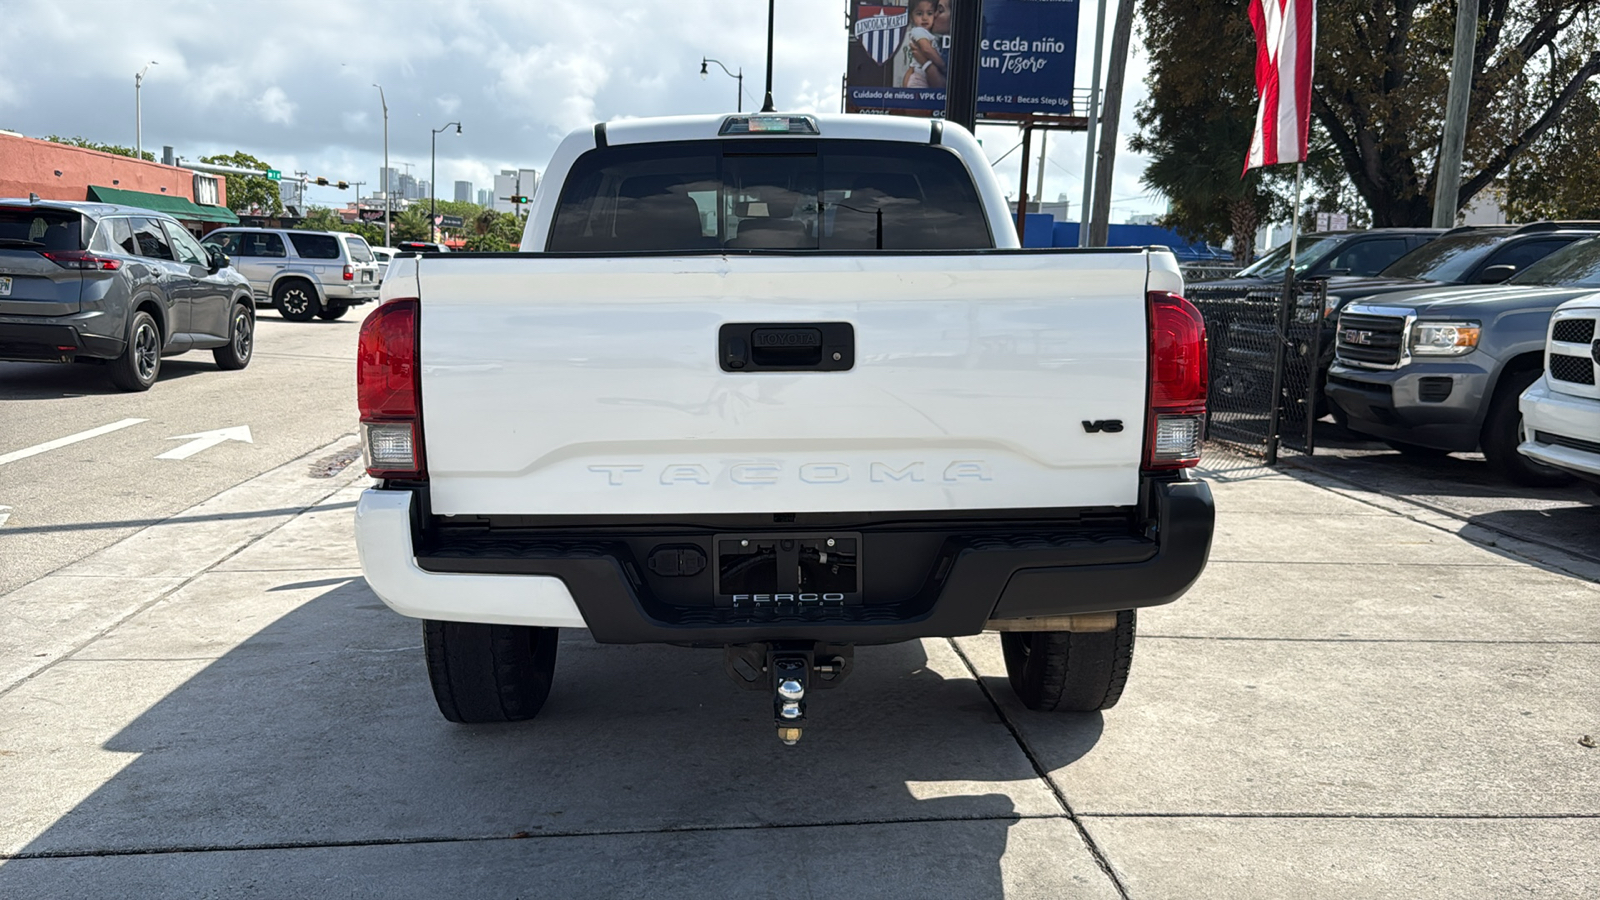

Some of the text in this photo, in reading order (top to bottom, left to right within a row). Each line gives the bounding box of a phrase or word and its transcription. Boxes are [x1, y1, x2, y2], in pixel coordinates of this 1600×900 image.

[856, 14, 907, 34] LINCOLN-MARTI
[993, 36, 1028, 51] cada
[1032, 37, 1065, 53] niño
[981, 52, 1048, 74] un Tesoro
[853, 90, 882, 99] Cuidado
[884, 90, 893, 99] de
[894, 91, 915, 100] niños
[919, 92, 935, 100] VPK
[996, 94, 1012, 103] K-12
[1017, 96, 1039, 104] Becas
[1040, 97, 1057, 106] Step
[1058, 97, 1069, 106] Up
[759, 333, 817, 345] TOYOTA
[1346, 329, 1372, 345] GMC
[1081, 419, 1124, 433] V6
[587, 460, 993, 486] TACOMA
[733, 593, 844, 602] FERCO
